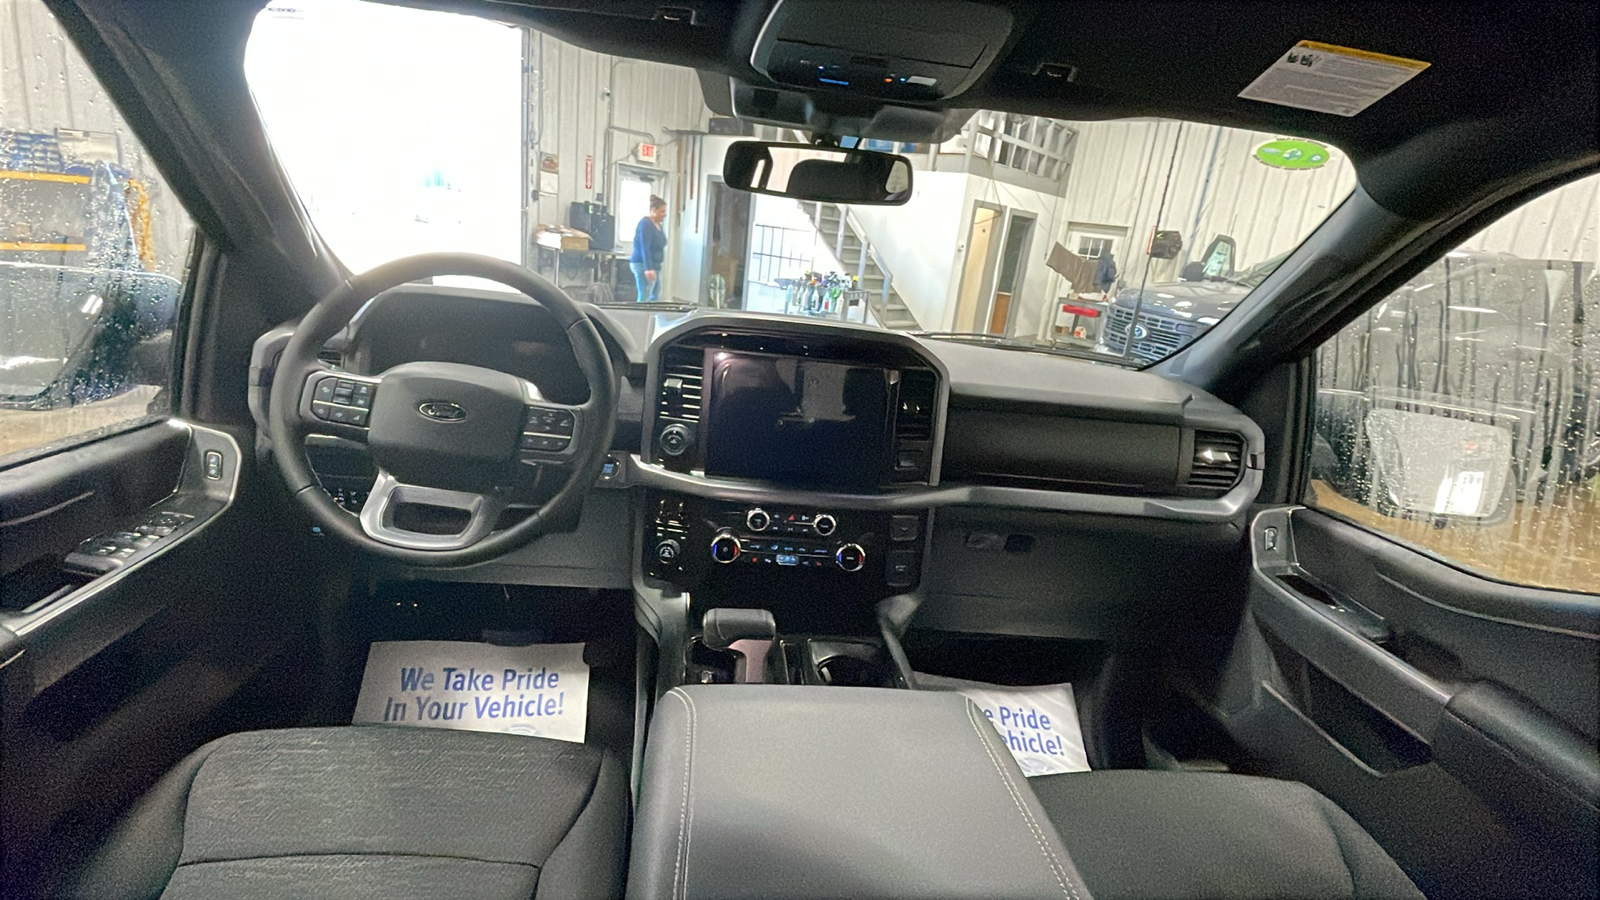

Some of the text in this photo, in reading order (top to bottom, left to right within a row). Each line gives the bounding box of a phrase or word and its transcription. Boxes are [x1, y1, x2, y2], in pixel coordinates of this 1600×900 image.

[400, 666, 559, 693] We Take Pride
[383, 692, 565, 722] In Your Vehicle!
[999, 706, 1051, 730] Pride
